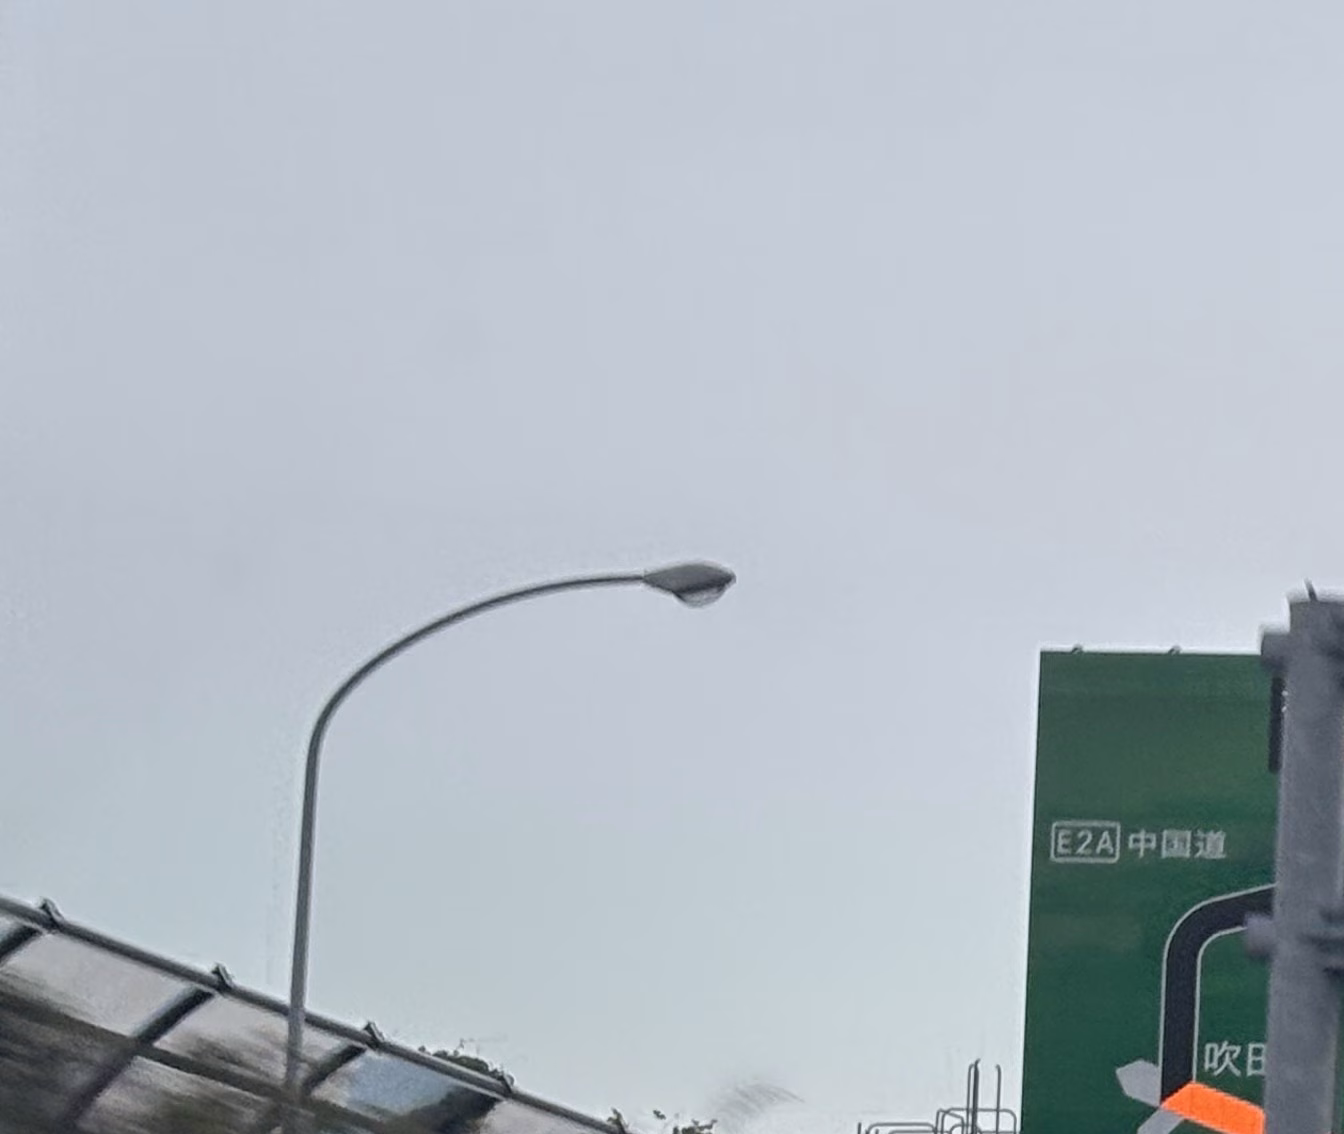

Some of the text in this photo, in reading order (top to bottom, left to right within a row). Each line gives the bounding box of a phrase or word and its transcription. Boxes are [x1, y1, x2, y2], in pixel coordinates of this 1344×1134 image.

[1057, 828, 1226, 859] E2A 中国道
